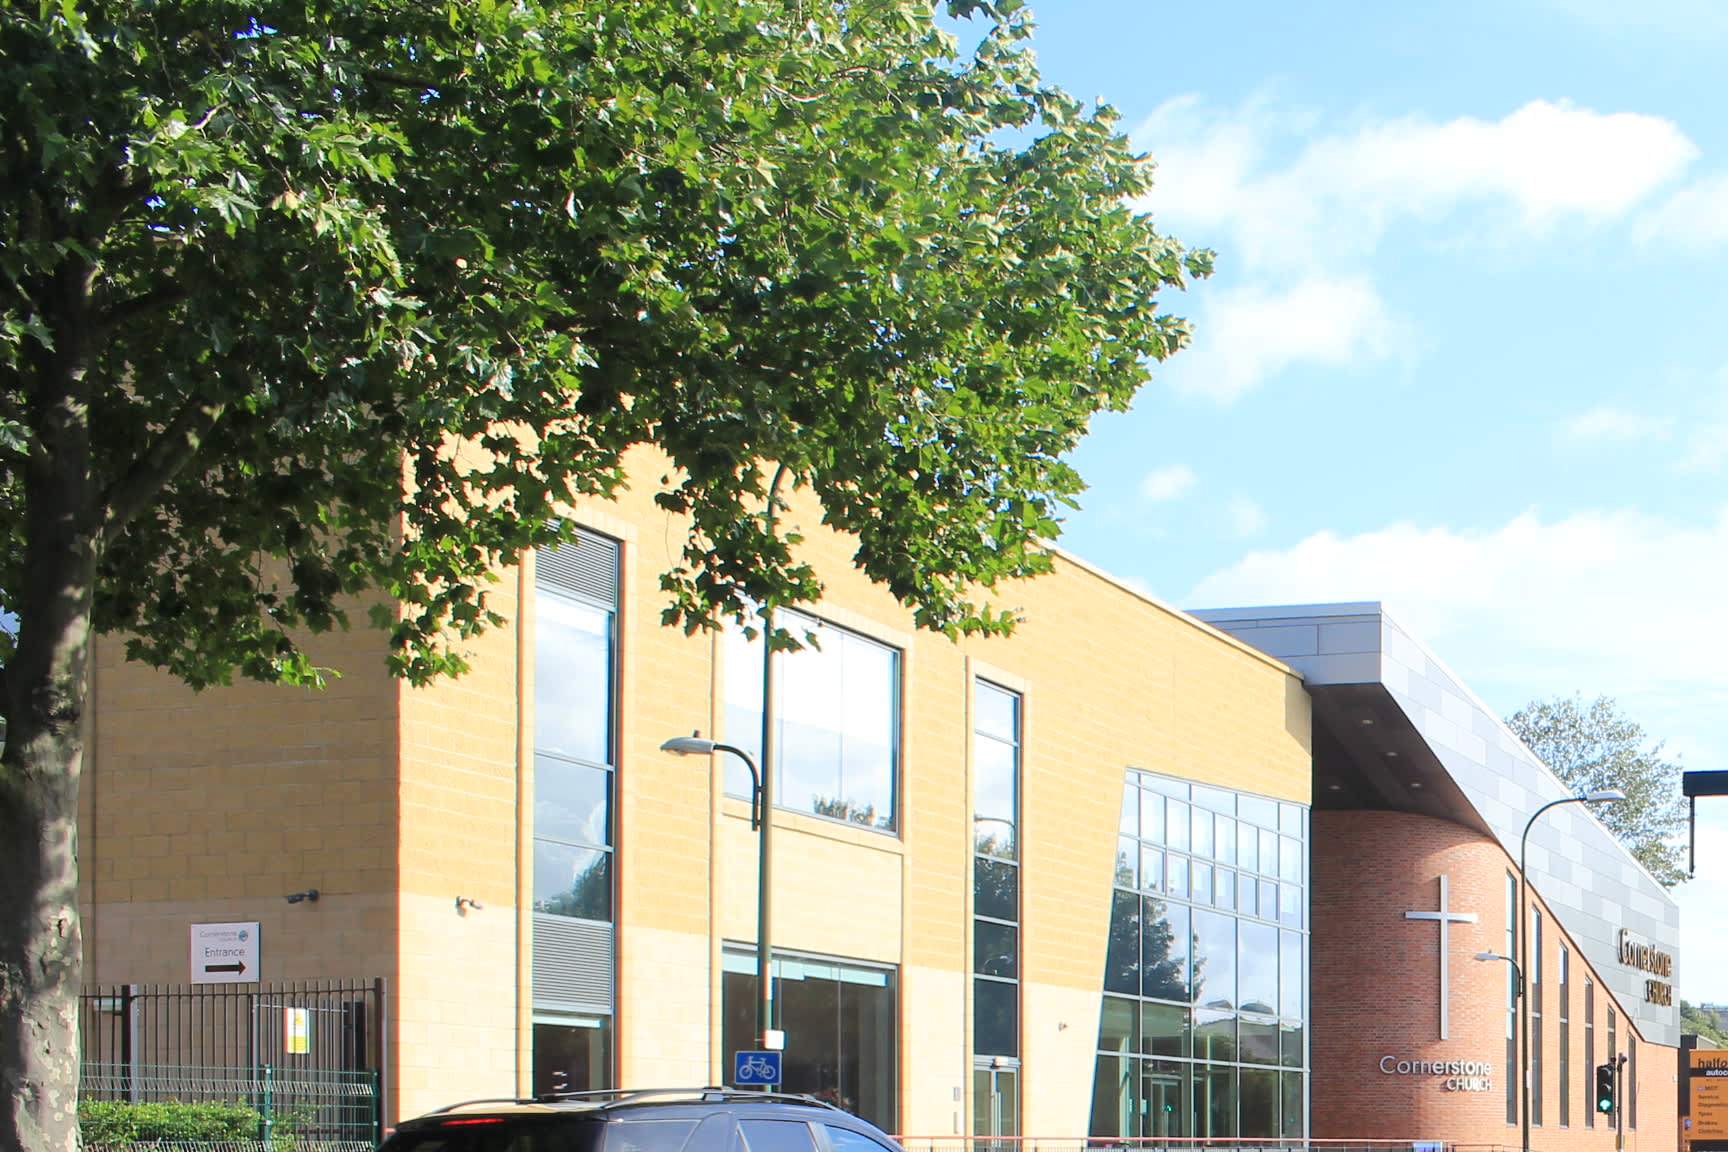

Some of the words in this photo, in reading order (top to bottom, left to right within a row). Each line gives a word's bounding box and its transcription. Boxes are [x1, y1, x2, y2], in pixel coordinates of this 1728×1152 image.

[205, 946, 246, 958] Entrance
[1617, 928, 1672, 978] Cornerstone
[1379, 1055, 1492, 1075] Cornerstone
[1447, 1077, 1492, 1091] CHURCH
